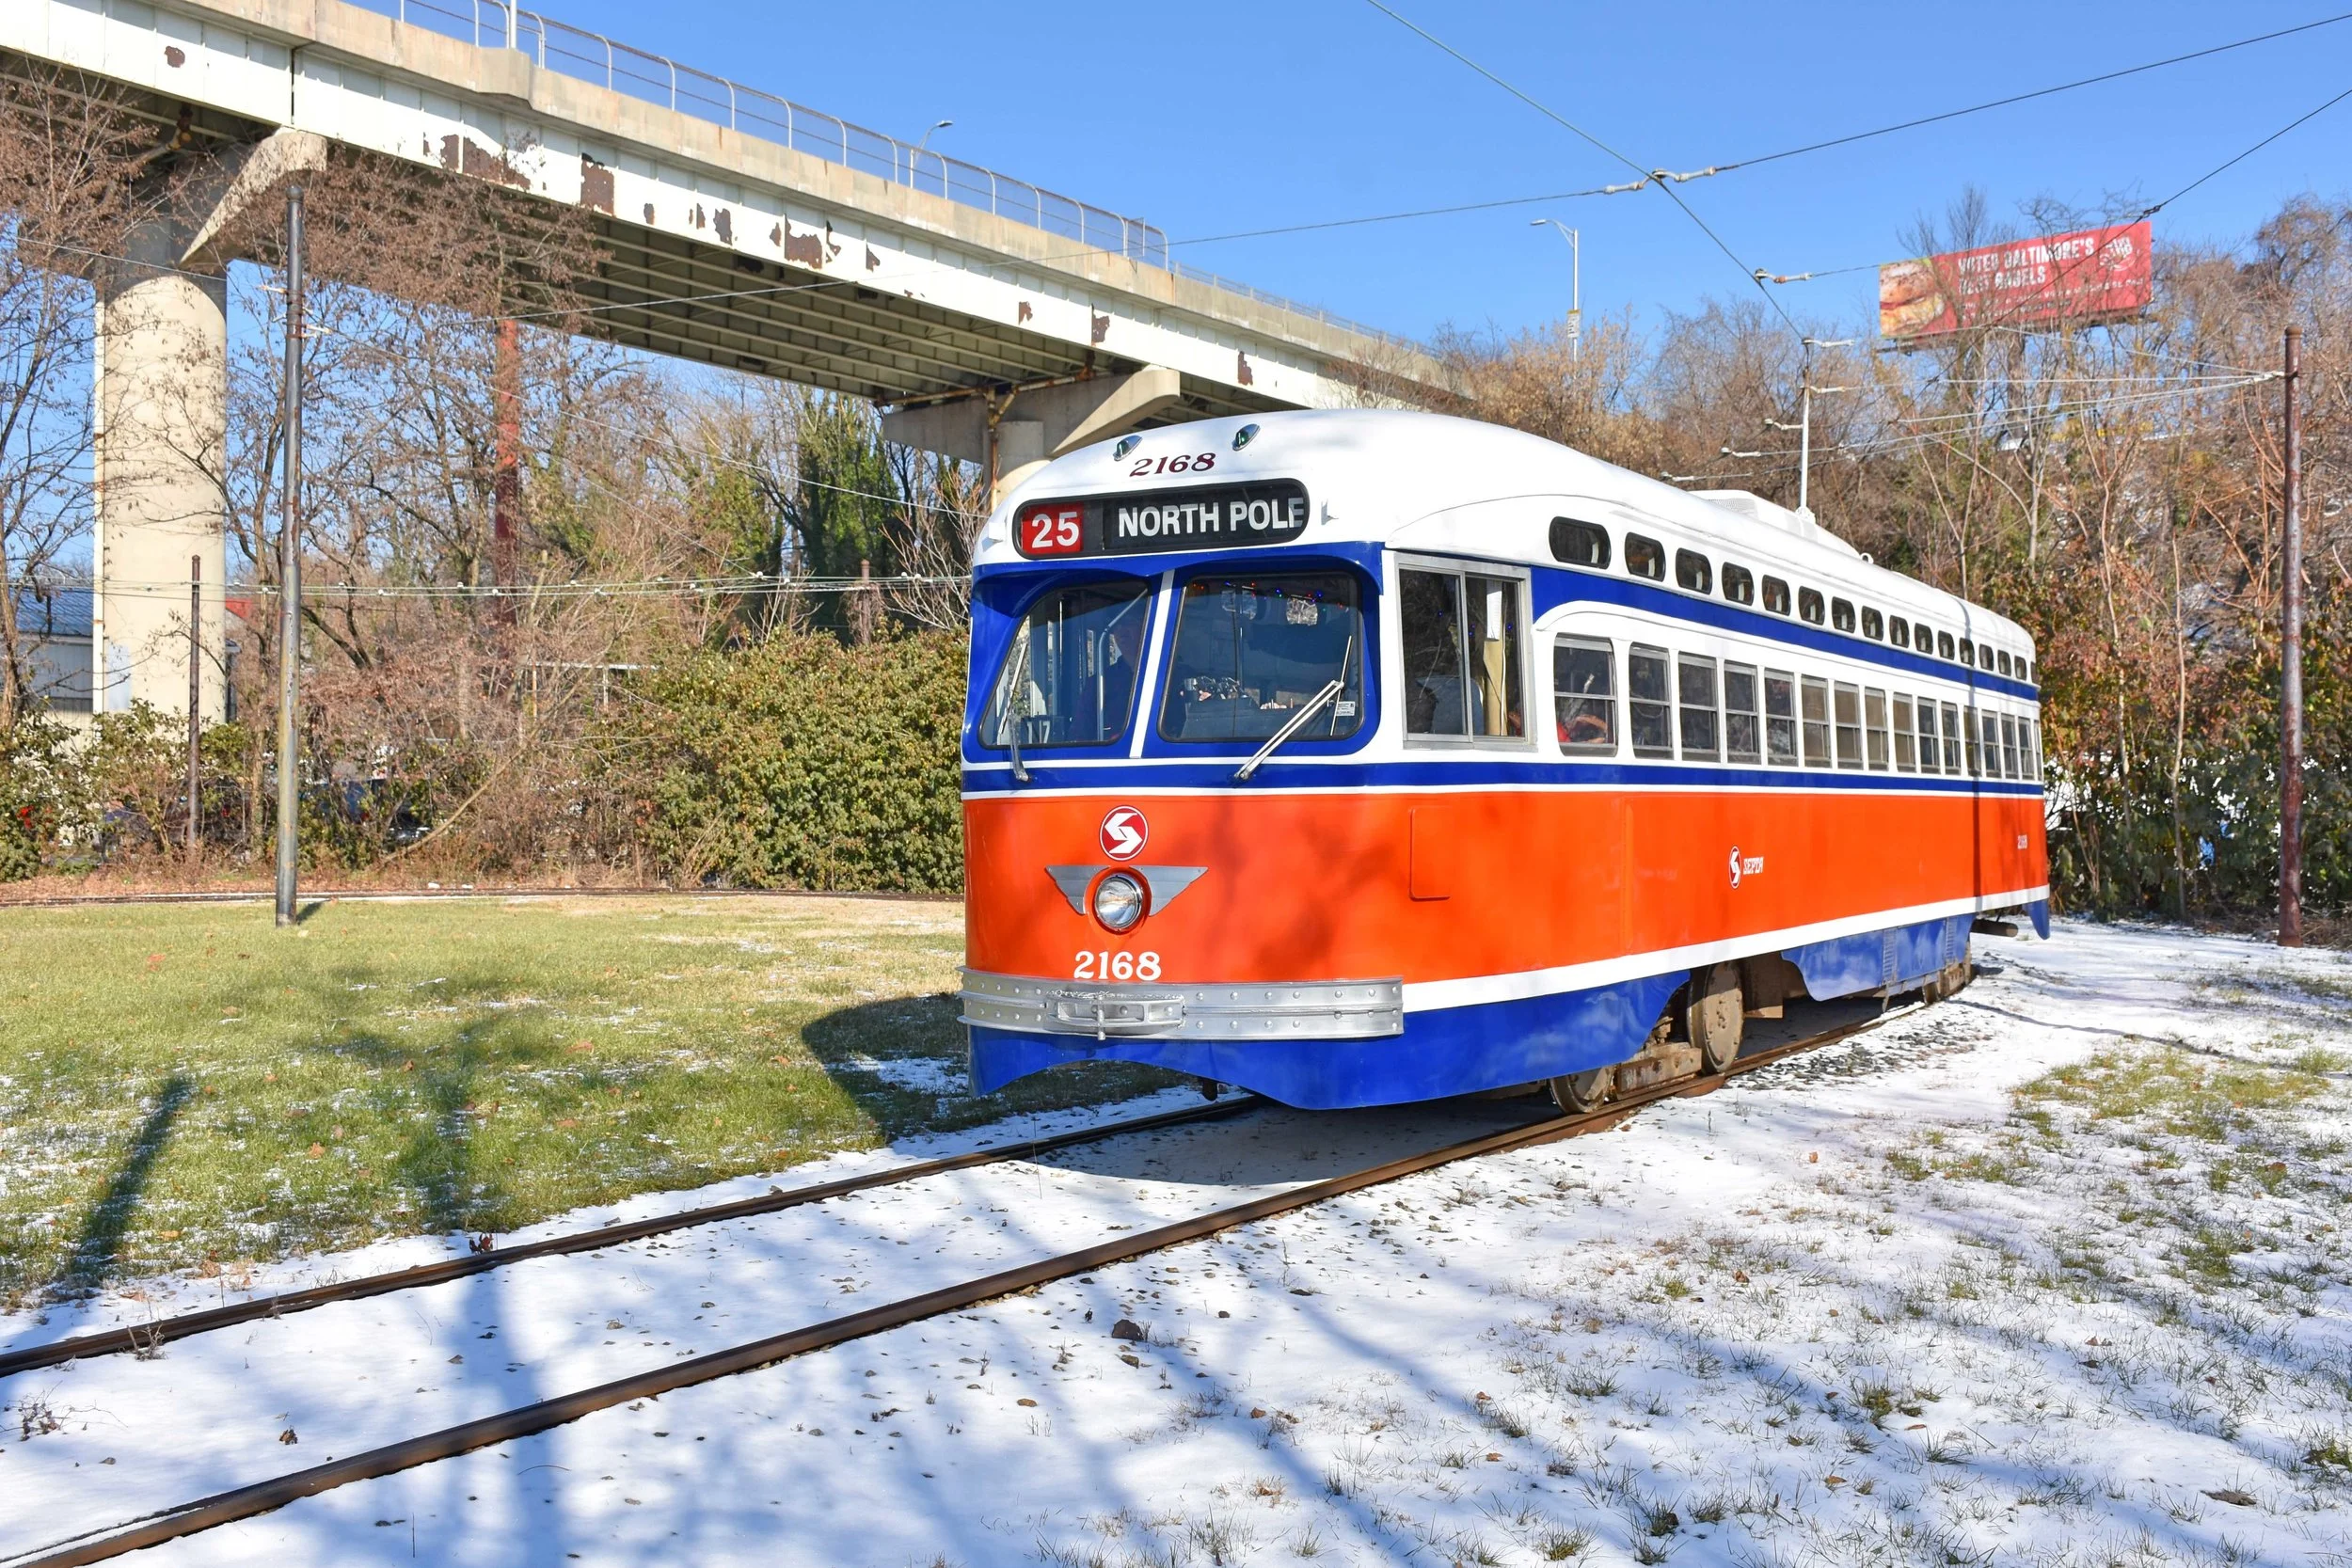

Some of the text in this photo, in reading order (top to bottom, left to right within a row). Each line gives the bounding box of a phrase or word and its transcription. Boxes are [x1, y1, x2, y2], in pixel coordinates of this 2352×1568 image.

[2003, 237, 2094, 270] BALTIMORE'S
[1129, 452, 1216, 477] 2168
[1031, 511, 1079, 548] 25
[1119, 497, 1304, 538] NORTH POLE
[1742, 856, 1765, 876] SEPTA
[1073, 950, 1162, 981] 2168
